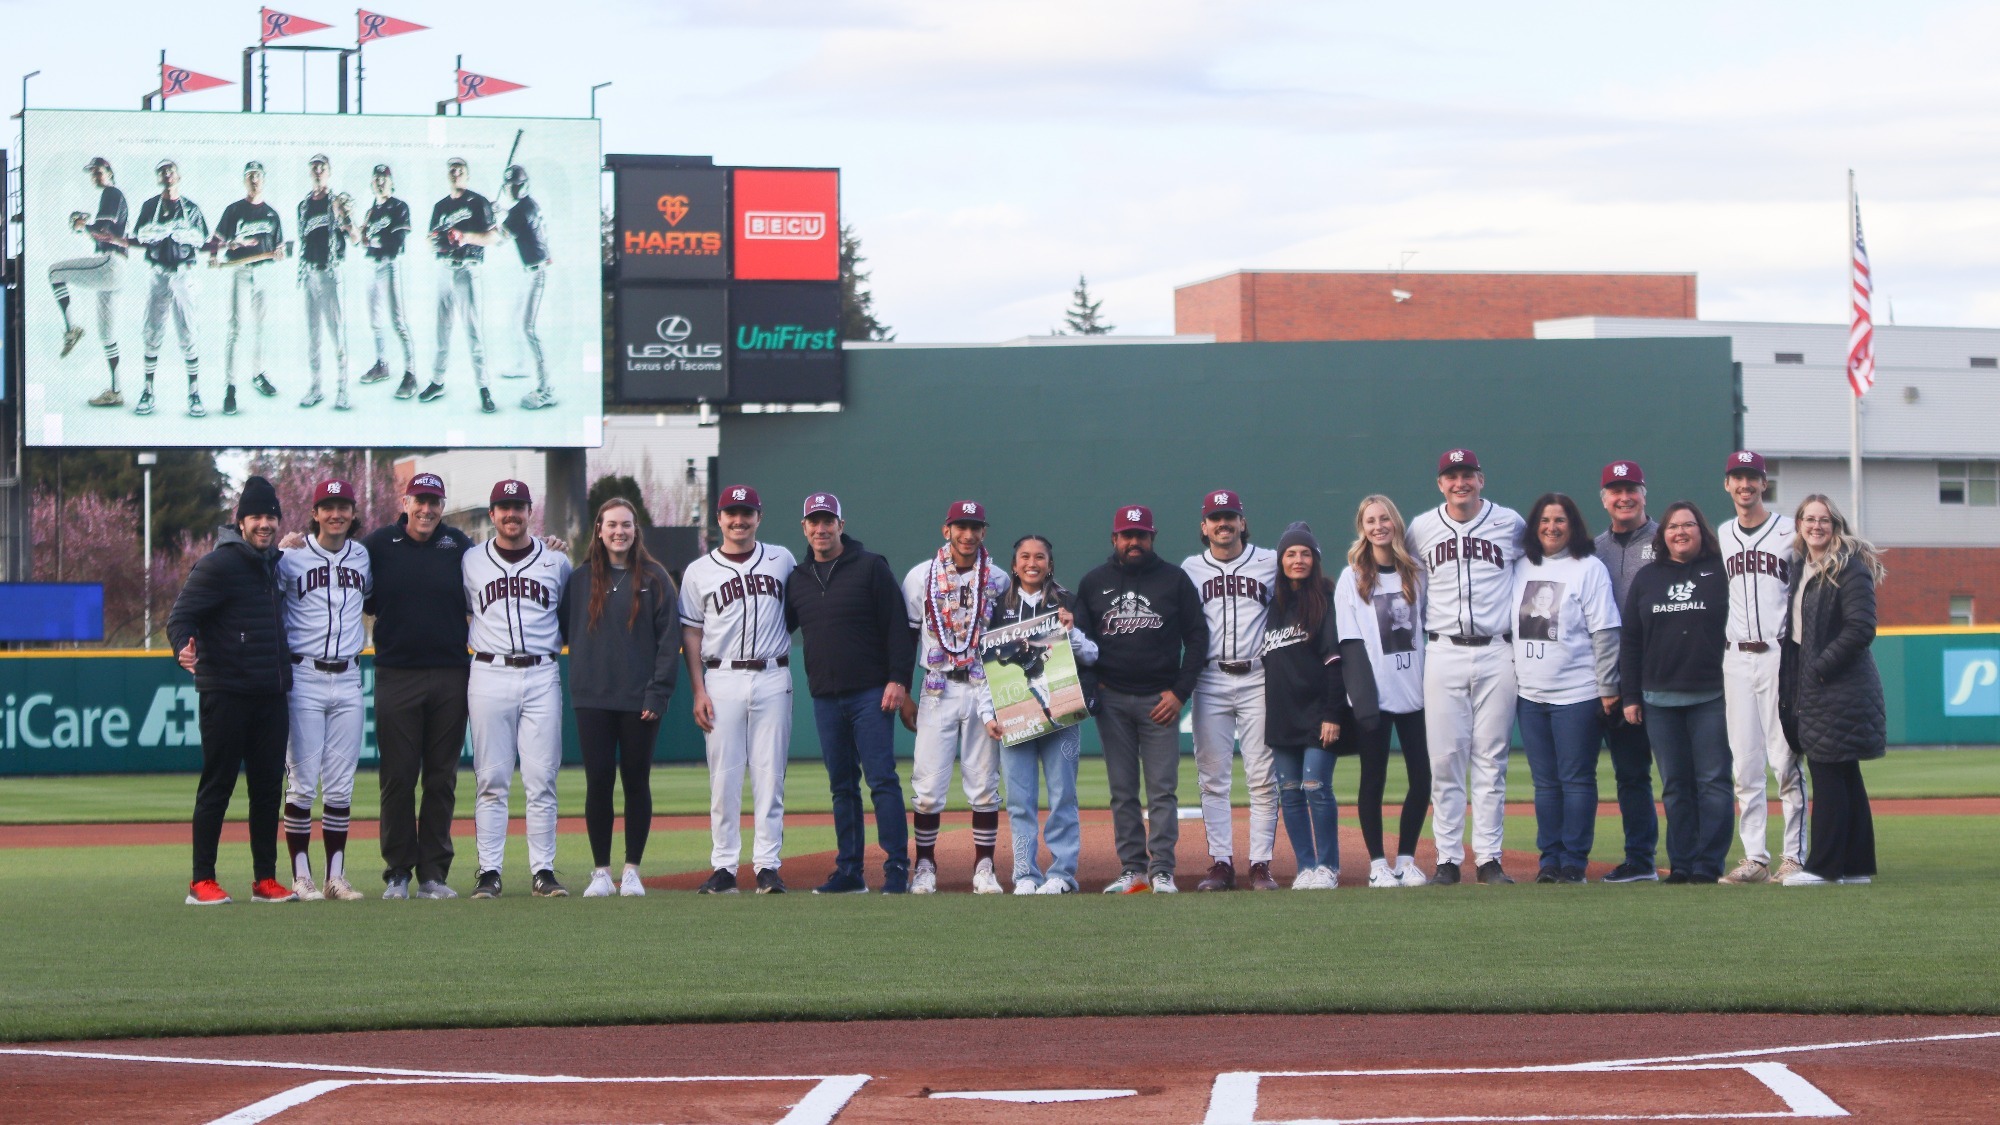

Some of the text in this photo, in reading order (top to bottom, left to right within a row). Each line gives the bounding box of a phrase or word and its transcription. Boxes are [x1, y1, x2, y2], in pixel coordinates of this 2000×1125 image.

[751, 218, 820, 234] BECU
[625, 231, 722, 250] HARTS
[737, 326, 836, 350] UniFirst
[627, 344, 722, 358] LEXUS
[627, 360, 722, 371] Lexus of Tacoma
[1428, 536, 1505, 574] LOGGERS
[1725, 550, 1790, 586] OGGERS
[478, 577, 551, 616] LOGGERS
[1202, 575, 1268, 608] OGGERS
[1652, 601, 1706, 614] BASEBALL
[980, 630, 1011, 656] Josh
[1526, 642, 1545, 660] DJ
[1395, 652, 1411, 671] DJ
[1006, 724, 1045, 743] ANGELS
